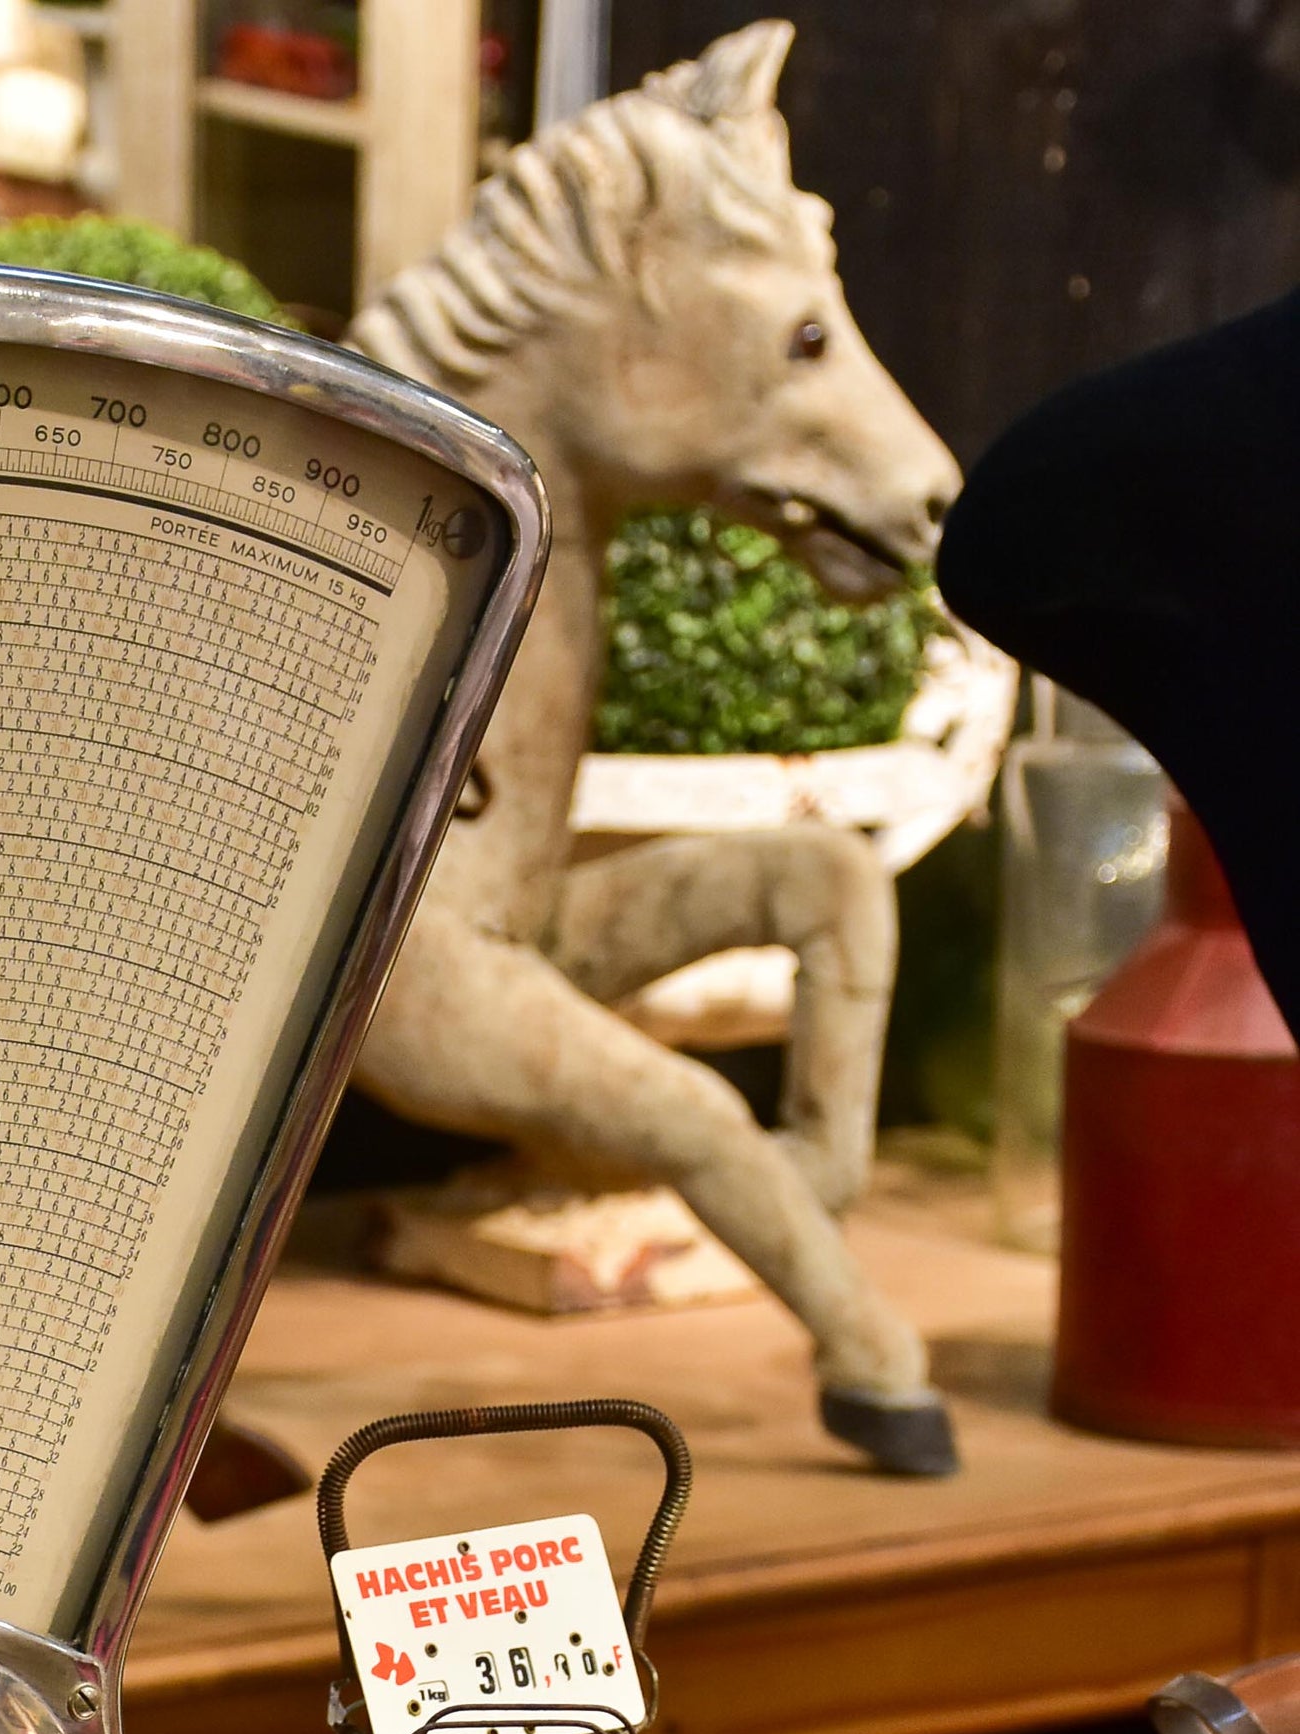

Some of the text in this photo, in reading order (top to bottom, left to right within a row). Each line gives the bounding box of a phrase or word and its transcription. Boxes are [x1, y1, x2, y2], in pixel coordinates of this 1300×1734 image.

[91, 396, 147, 427] 700
[203, 423, 261, 458] 800
[305, 458, 360, 497] 900
[35, 425, 81, 446] 650
[152, 445, 192, 469] 750
[253, 475, 295, 503] 850
[346, 514, 387, 544] 950
[151, 517, 220, 547] PORTÉE
[231, 541, 320, 585] MAXIMUM
[356, 1537, 583, 1599] HACHIS PORC
[409, 1580, 549, 1628] ET VEAU
